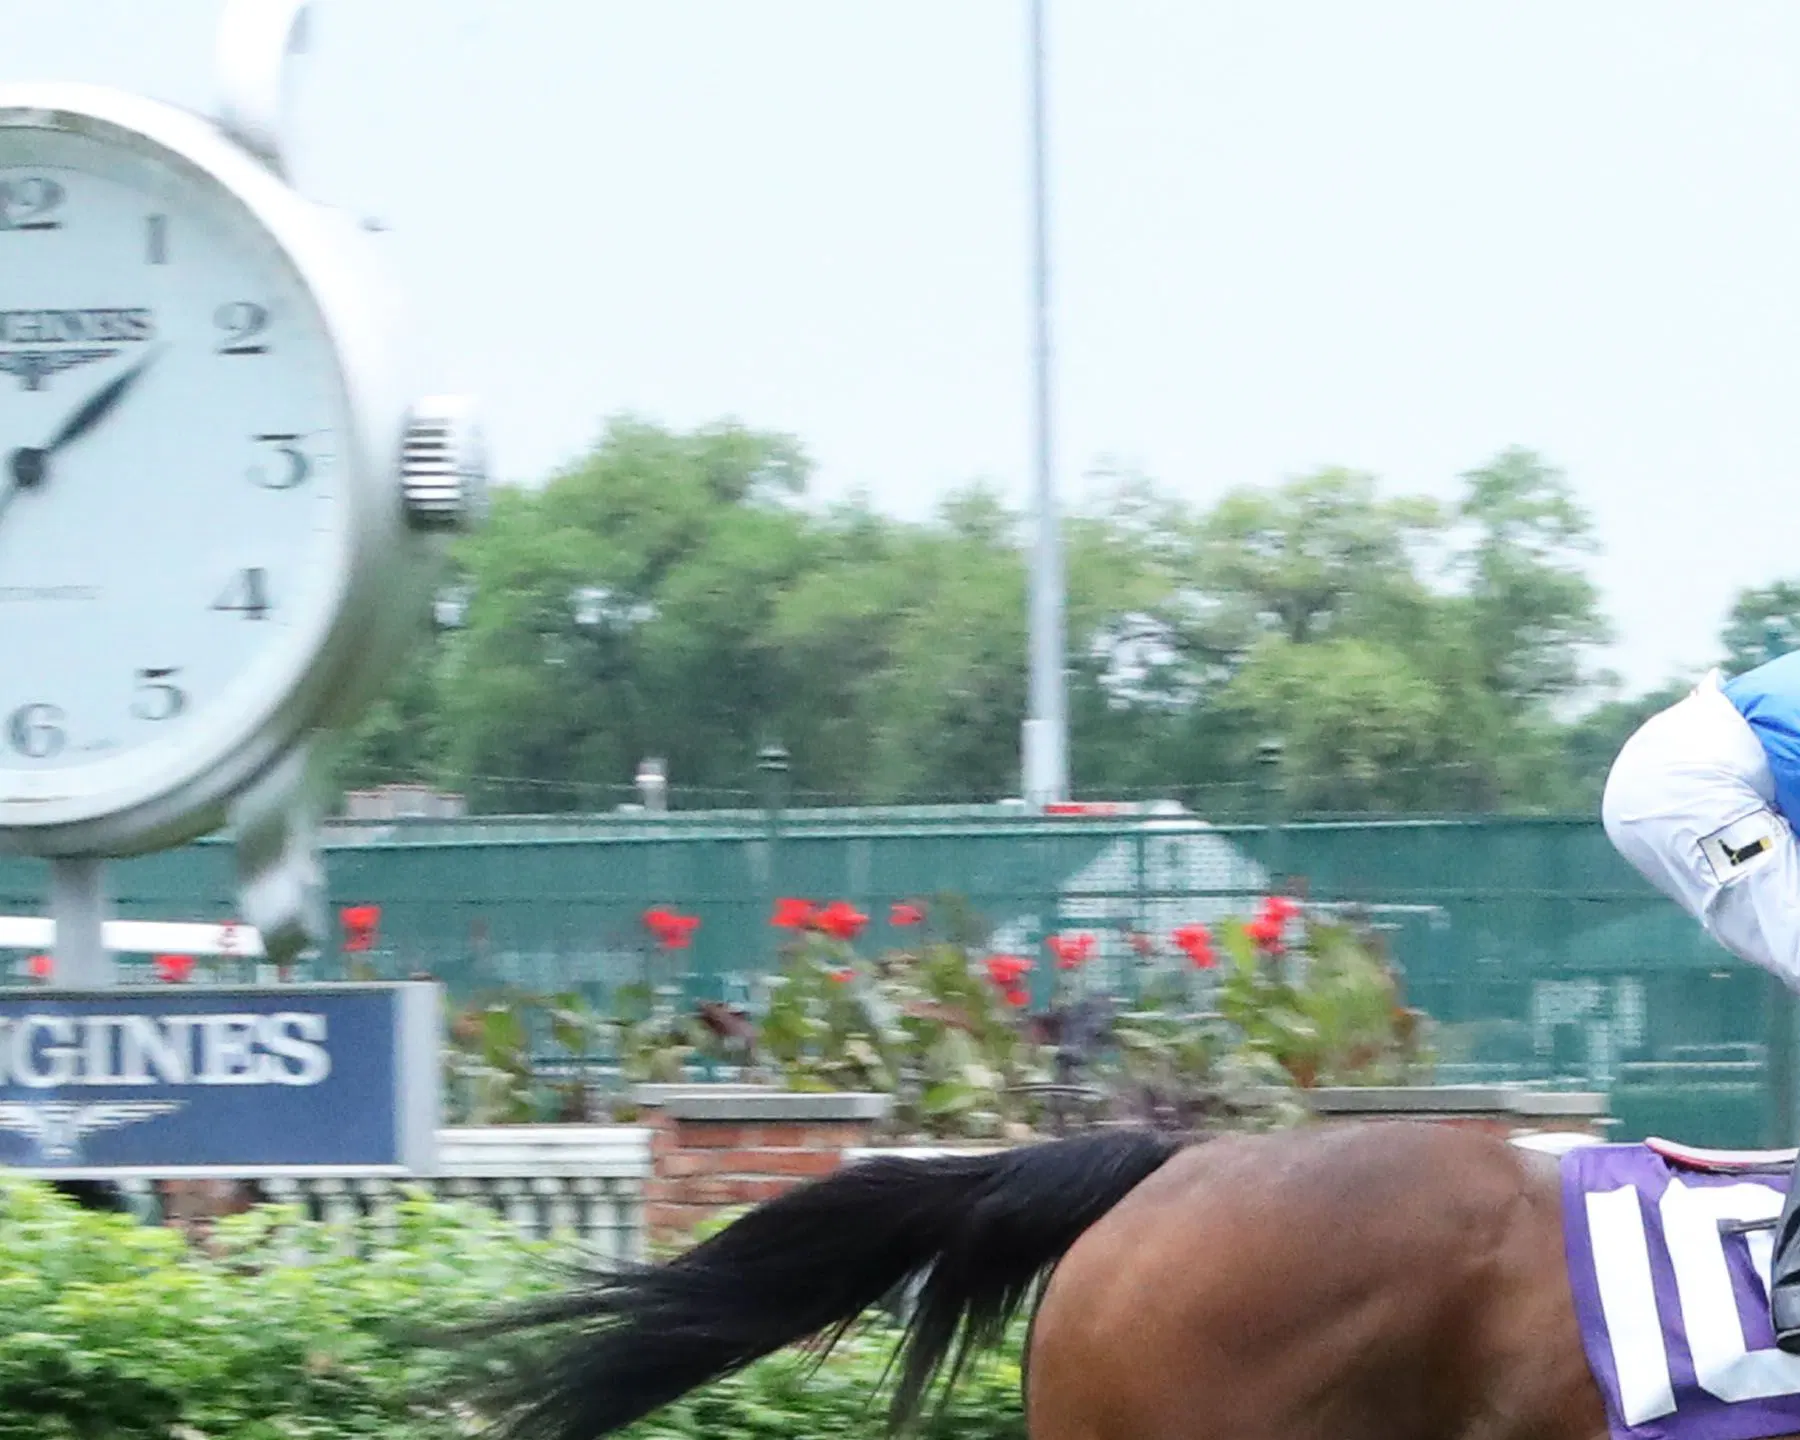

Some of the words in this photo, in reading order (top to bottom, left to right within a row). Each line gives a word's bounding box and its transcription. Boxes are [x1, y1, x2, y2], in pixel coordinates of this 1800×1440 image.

[145, 213, 168, 264] 1
[212, 302, 270, 354] 2
[246, 434, 313, 490] 3
[208, 567, 271, 620] 4
[130, 666, 187, 720] 5
[8, 703, 66, 758] 6
[0, 1013, 333, 1087] GINES
